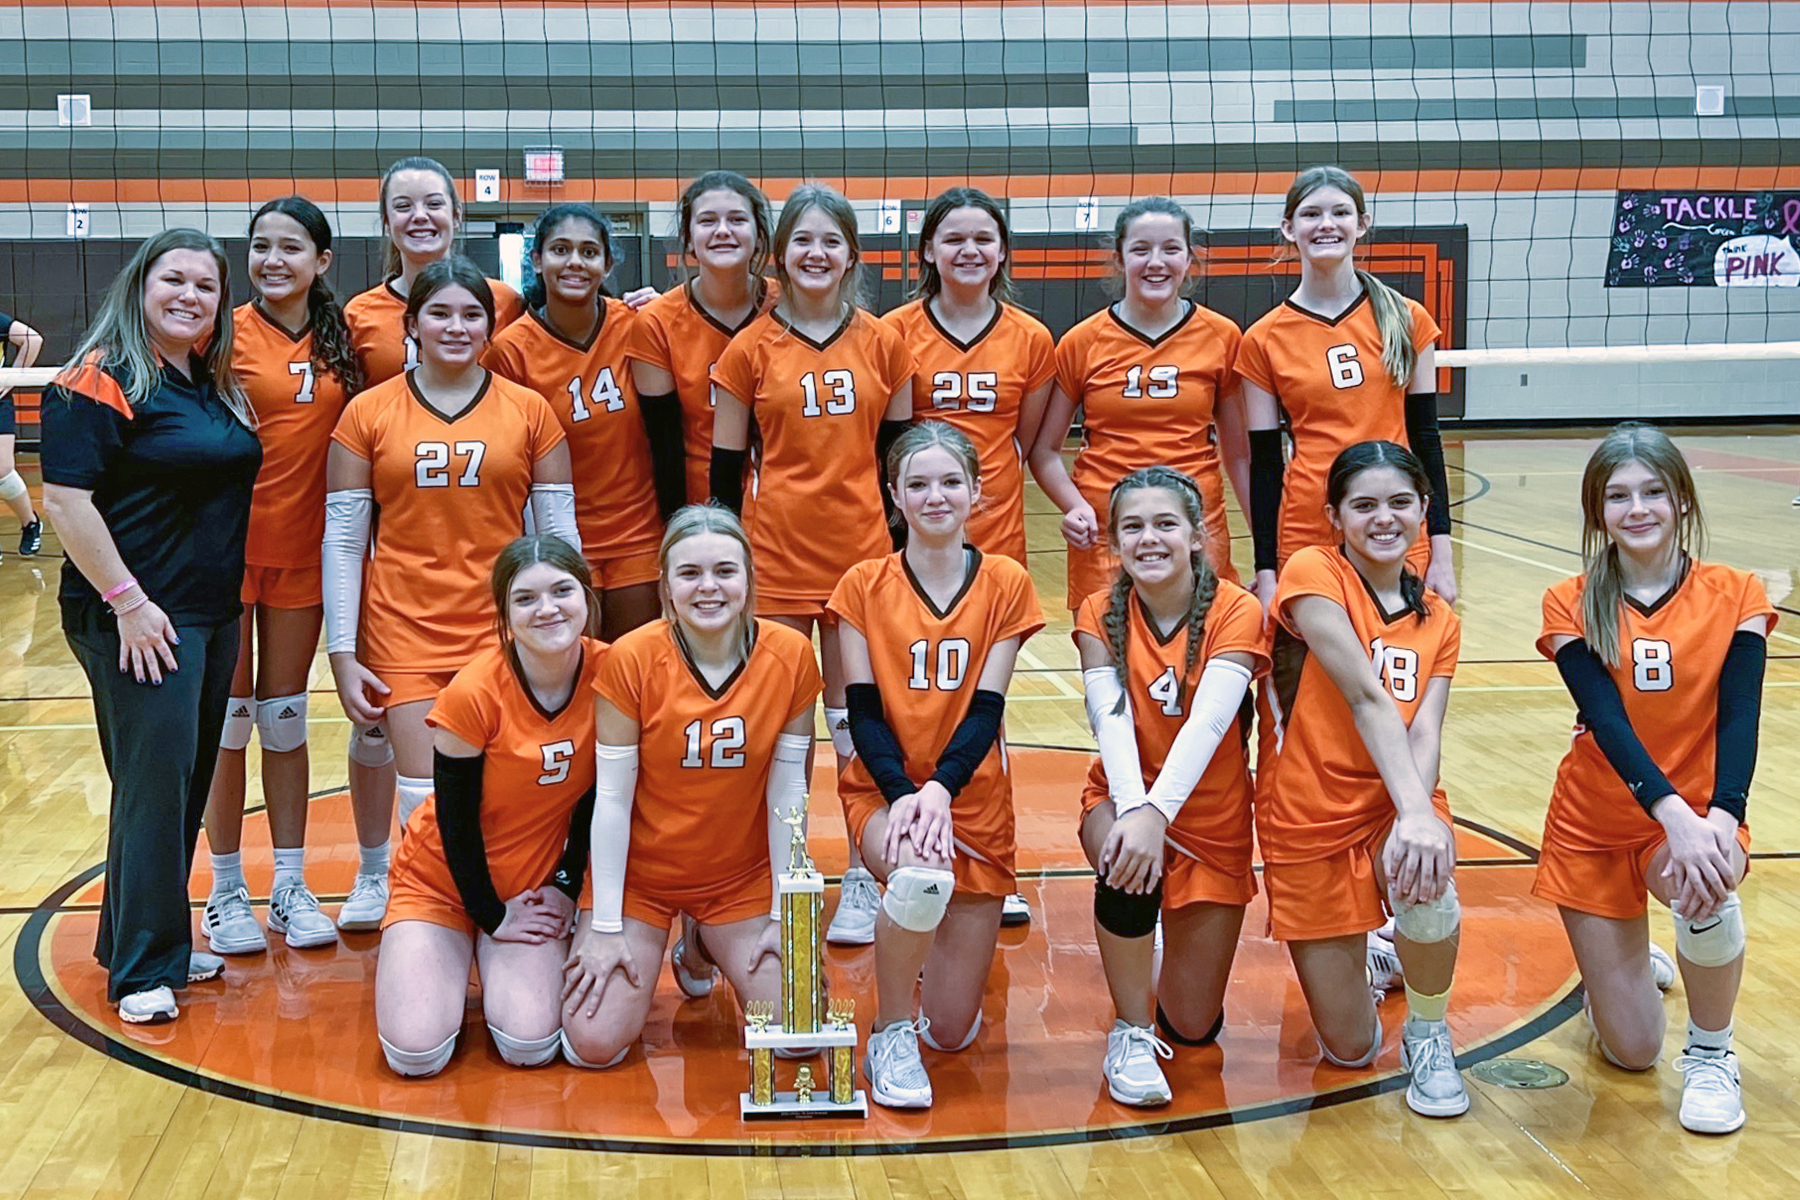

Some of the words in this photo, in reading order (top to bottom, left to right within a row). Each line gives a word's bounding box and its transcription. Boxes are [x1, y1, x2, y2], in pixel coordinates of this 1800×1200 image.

[484, 186, 491, 195] 4
[1661, 197, 1757, 221] TACKLE
[76, 219, 84, 229] 2
[885, 216, 893, 226] 6
[1083, 213, 1090, 222] 7
[1726, 252, 1785, 282] PINK
[288, 361, 315, 403] 7
[1122, 364, 1179, 399] 19
[1326, 343, 1365, 389] 6
[567, 366, 626, 423] 14
[799, 368, 857, 418] 13
[932, 371, 998, 412] 25
[414, 440, 487, 488] 27
[908, 637, 971, 692] 10
[1369, 635, 1419, 703] 18
[1631, 637, 1674, 692] 8
[1147, 665, 1184, 717] 4
[536, 739, 575, 786] 5
[680, 715, 746, 769] 12
[747, 1000, 774, 1016] 2022
[828, 998, 856, 1014] 2022
